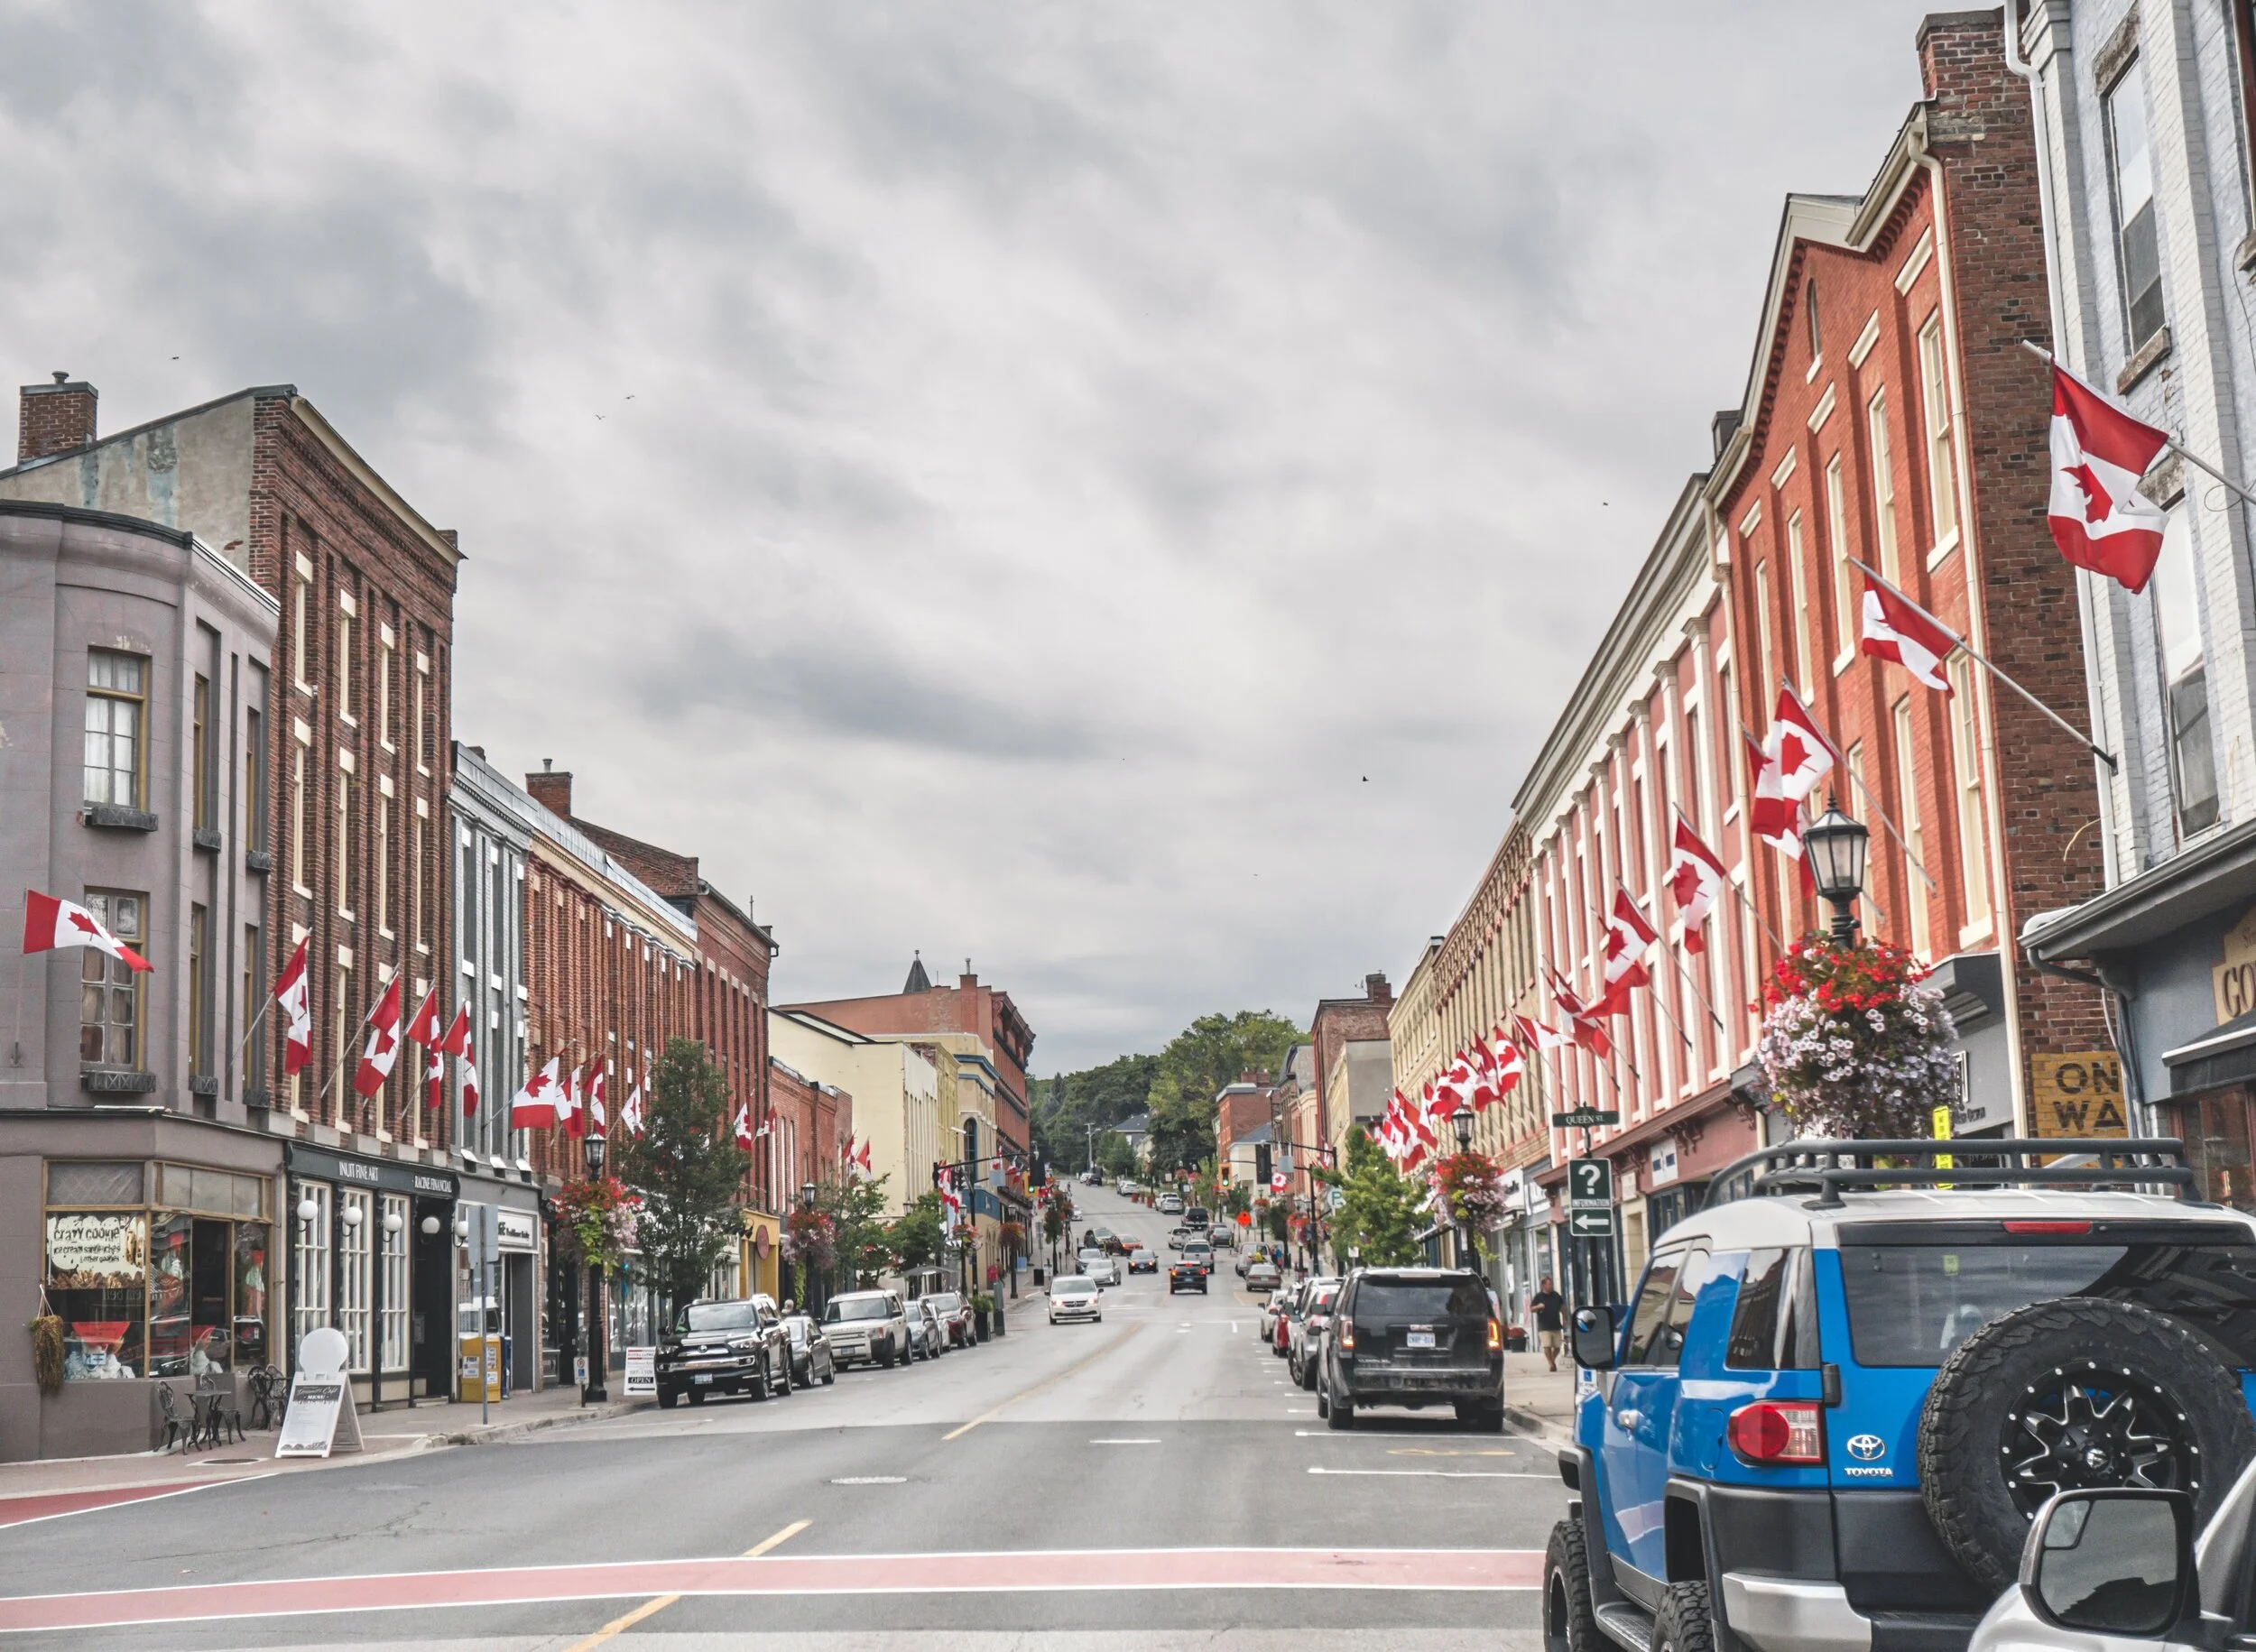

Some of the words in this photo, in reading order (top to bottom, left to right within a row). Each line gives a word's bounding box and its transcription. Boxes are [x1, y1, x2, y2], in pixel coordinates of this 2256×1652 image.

[2223, 962, 2256, 1018] GO
[2055, 1061, 2120, 1094] ON
[1565, 1114, 1595, 1126] QUEEN
[2053, 1100, 2125, 1131] WA
[338, 1160, 355, 1178] INUIT
[355, 1164, 367, 1180] FINE
[367, 1167, 378, 1182] ART
[414, 1176, 430, 1189] RACINE
[430, 1177, 452, 1194] FINANCIAL
[1331, 1191, 1342, 1206] P
[1572, 1199, 1611, 1208] INFORMATION
[1844, 1467, 1893, 1478] TOYOTA
